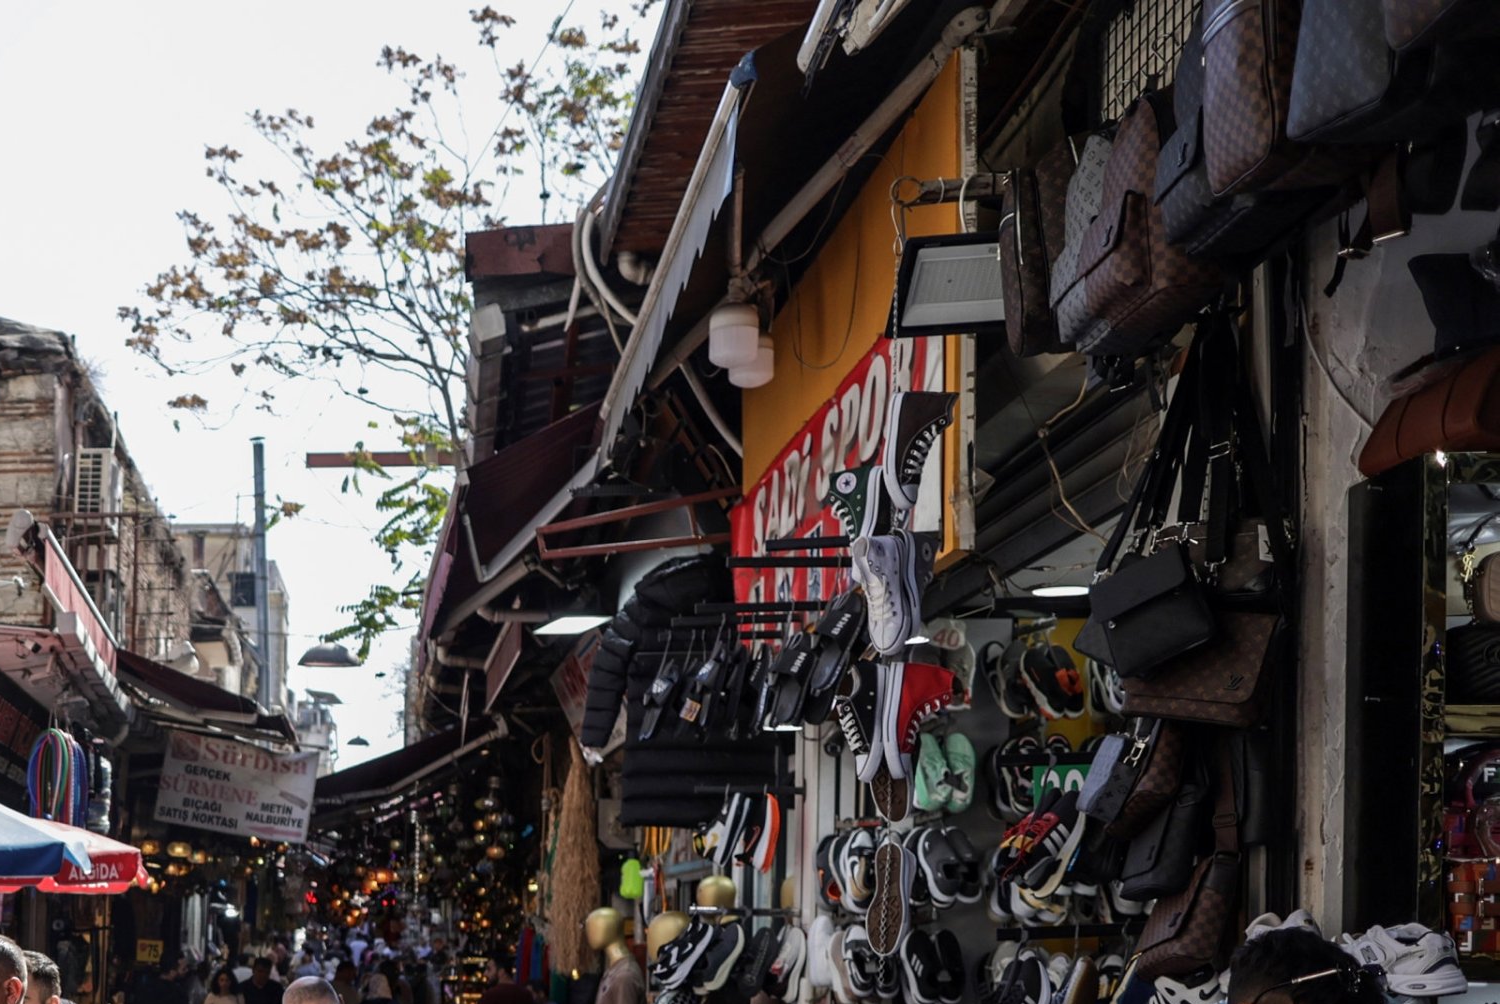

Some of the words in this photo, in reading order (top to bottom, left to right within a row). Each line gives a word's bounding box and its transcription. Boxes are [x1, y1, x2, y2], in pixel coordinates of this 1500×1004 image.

[185, 764, 231, 781] GERÇEK
[159, 774, 259, 805] SÜRMENE
[158, 806, 188, 822] SATIŞ
[191, 811, 239, 829] NOKTASI
